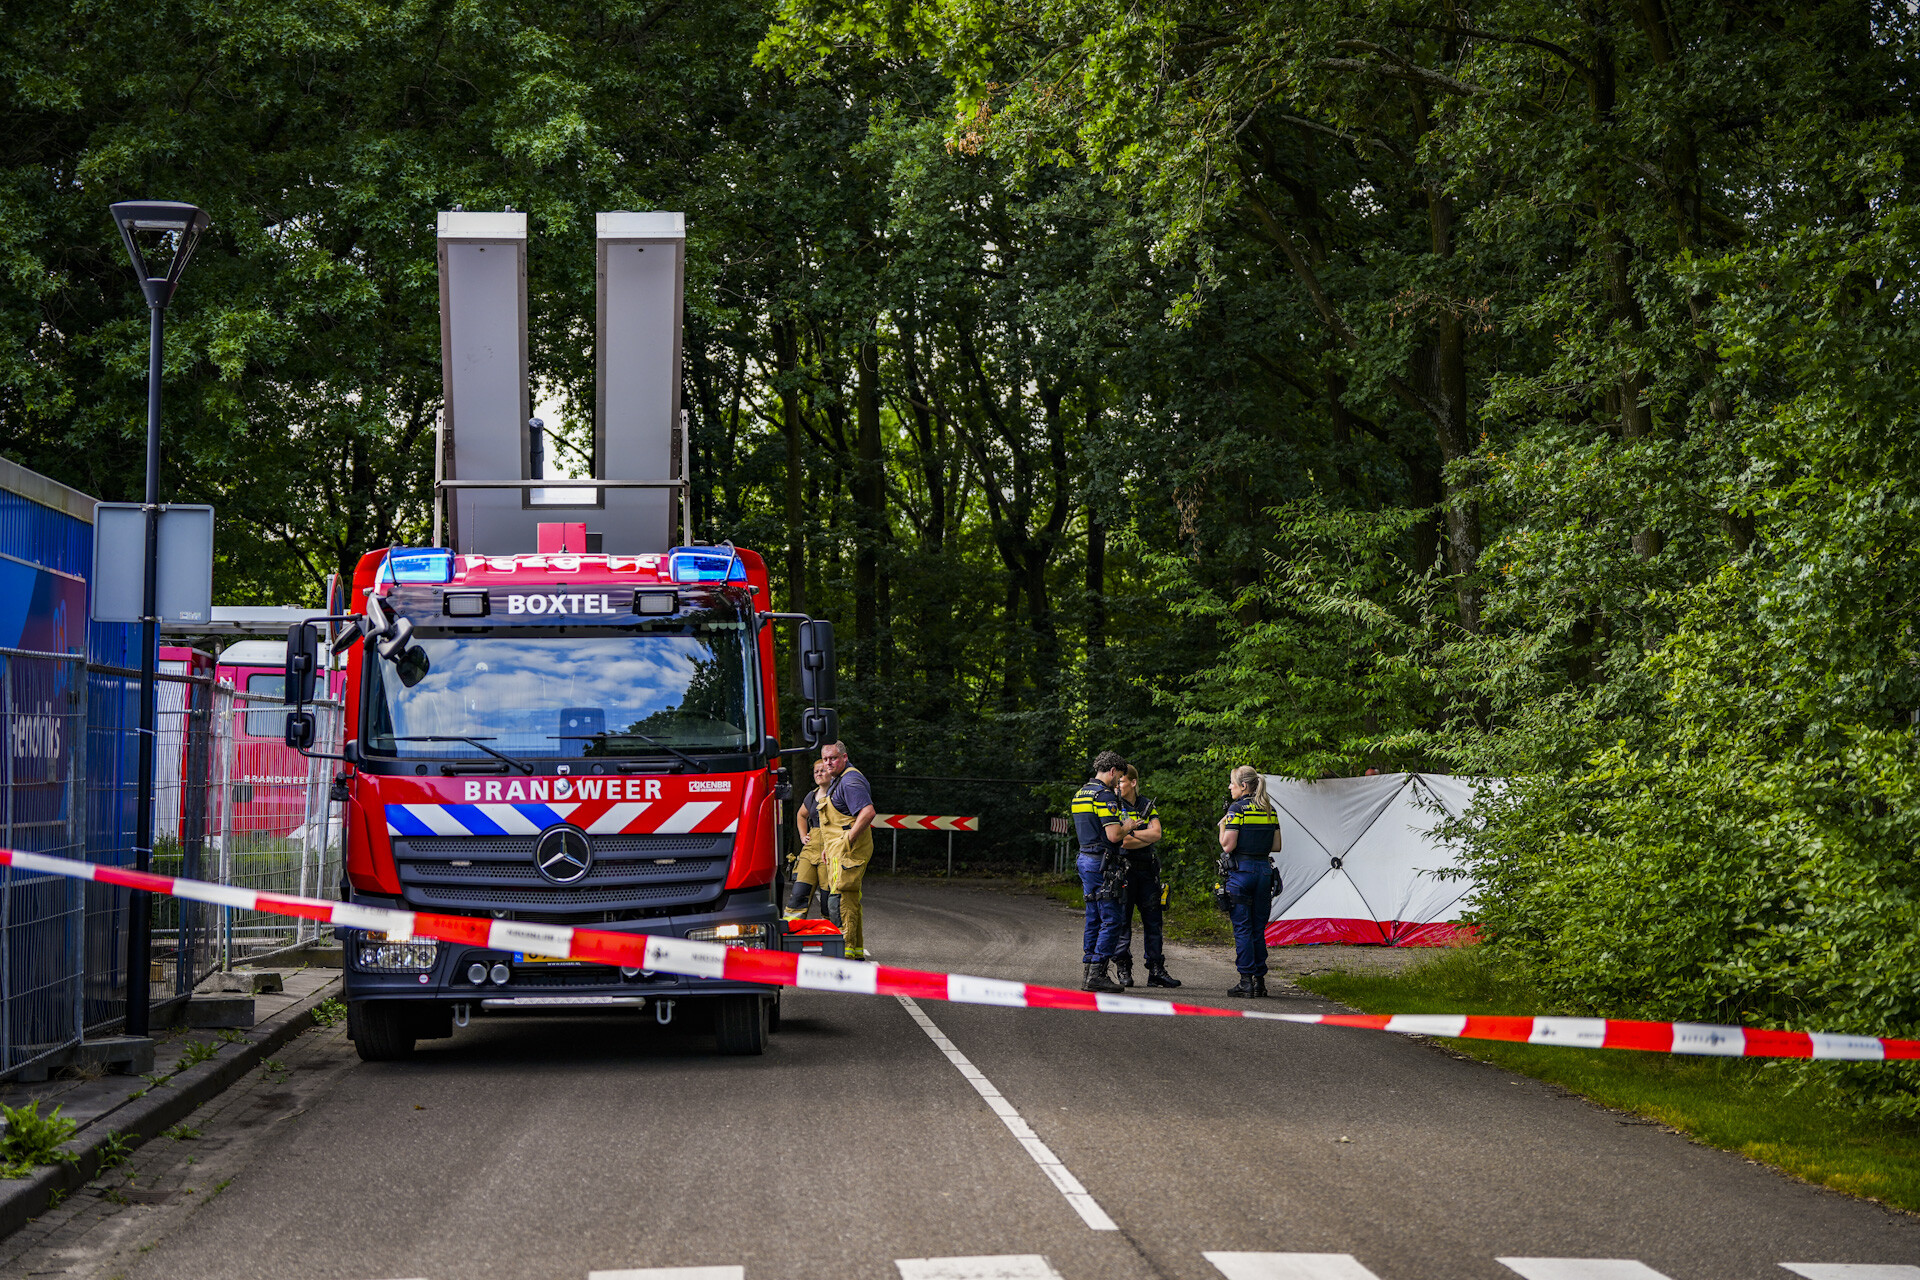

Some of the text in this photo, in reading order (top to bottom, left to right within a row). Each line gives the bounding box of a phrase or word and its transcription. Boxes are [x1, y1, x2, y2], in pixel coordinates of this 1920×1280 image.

[508, 594, 616, 614] BOXTEL
[12, 701, 60, 759] Hendriks
[464, 779, 662, 801] BRANDWEER
[700, 780, 731, 789] KENBRI
